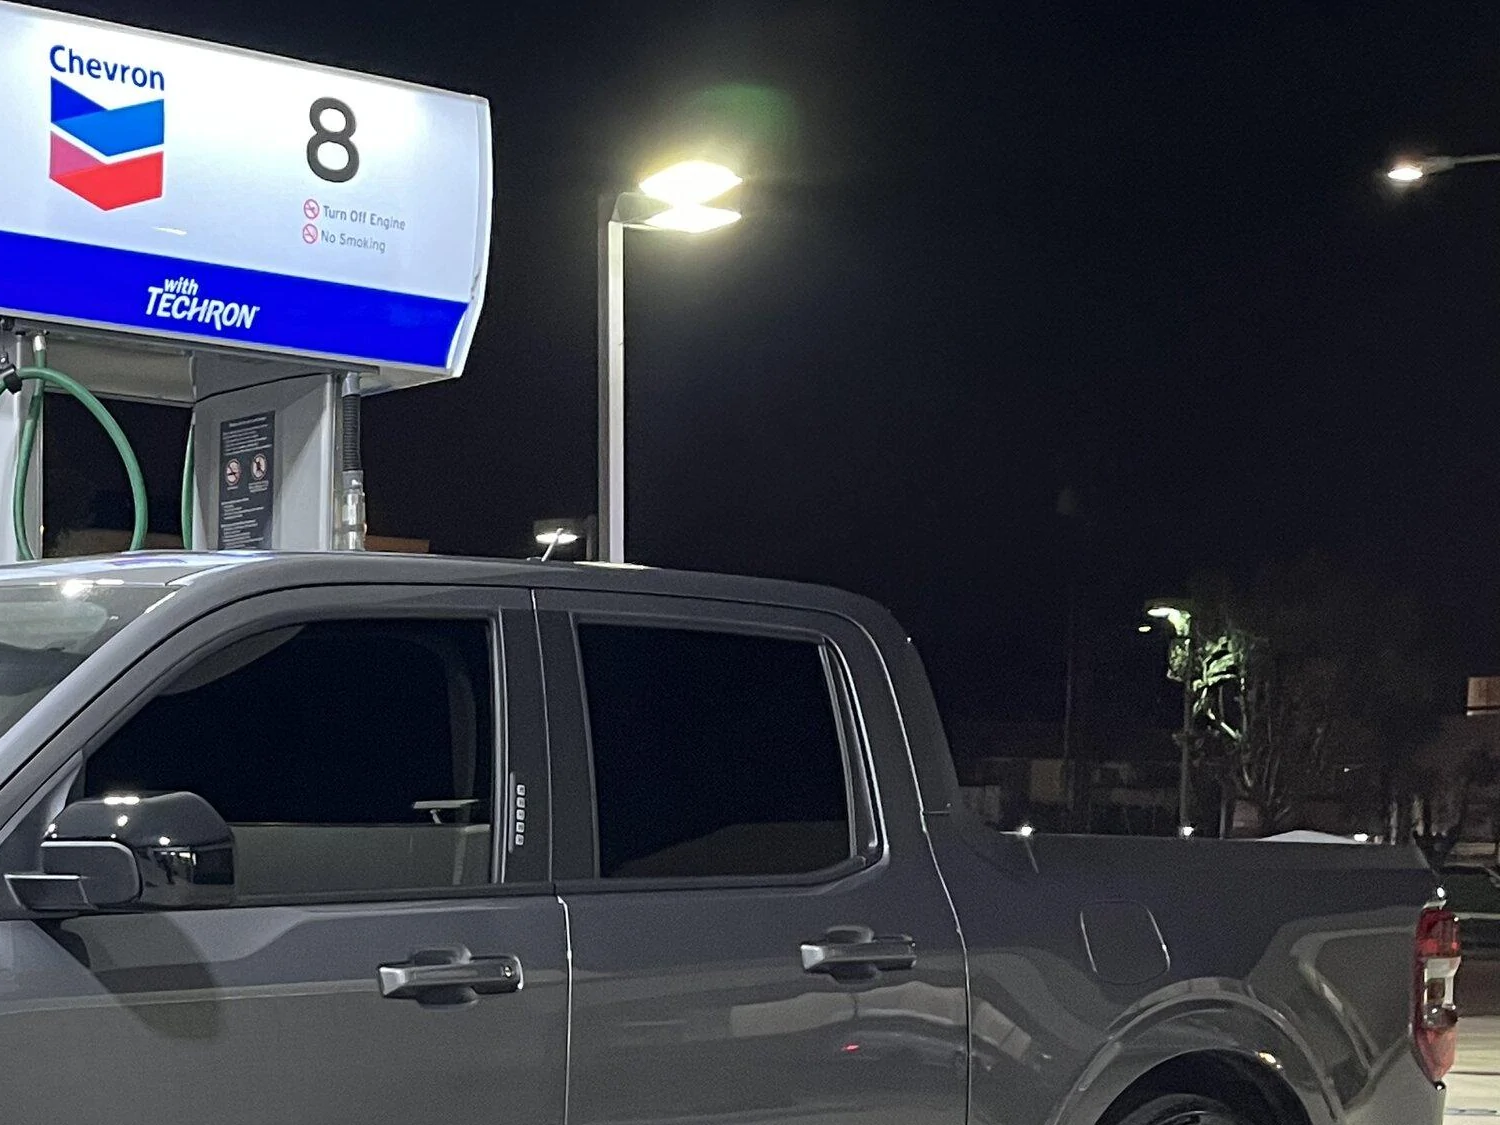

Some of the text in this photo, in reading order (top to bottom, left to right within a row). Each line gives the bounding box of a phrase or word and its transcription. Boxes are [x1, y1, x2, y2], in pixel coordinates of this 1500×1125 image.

[49, 44, 164, 91] Chevron
[306, 96, 360, 183] 8
[323, 205, 406, 231] Turn Off Engine
[321, 230, 386, 254] No Smoking
[164, 276, 199, 296] with
[145, 286, 257, 331] TECHRON
